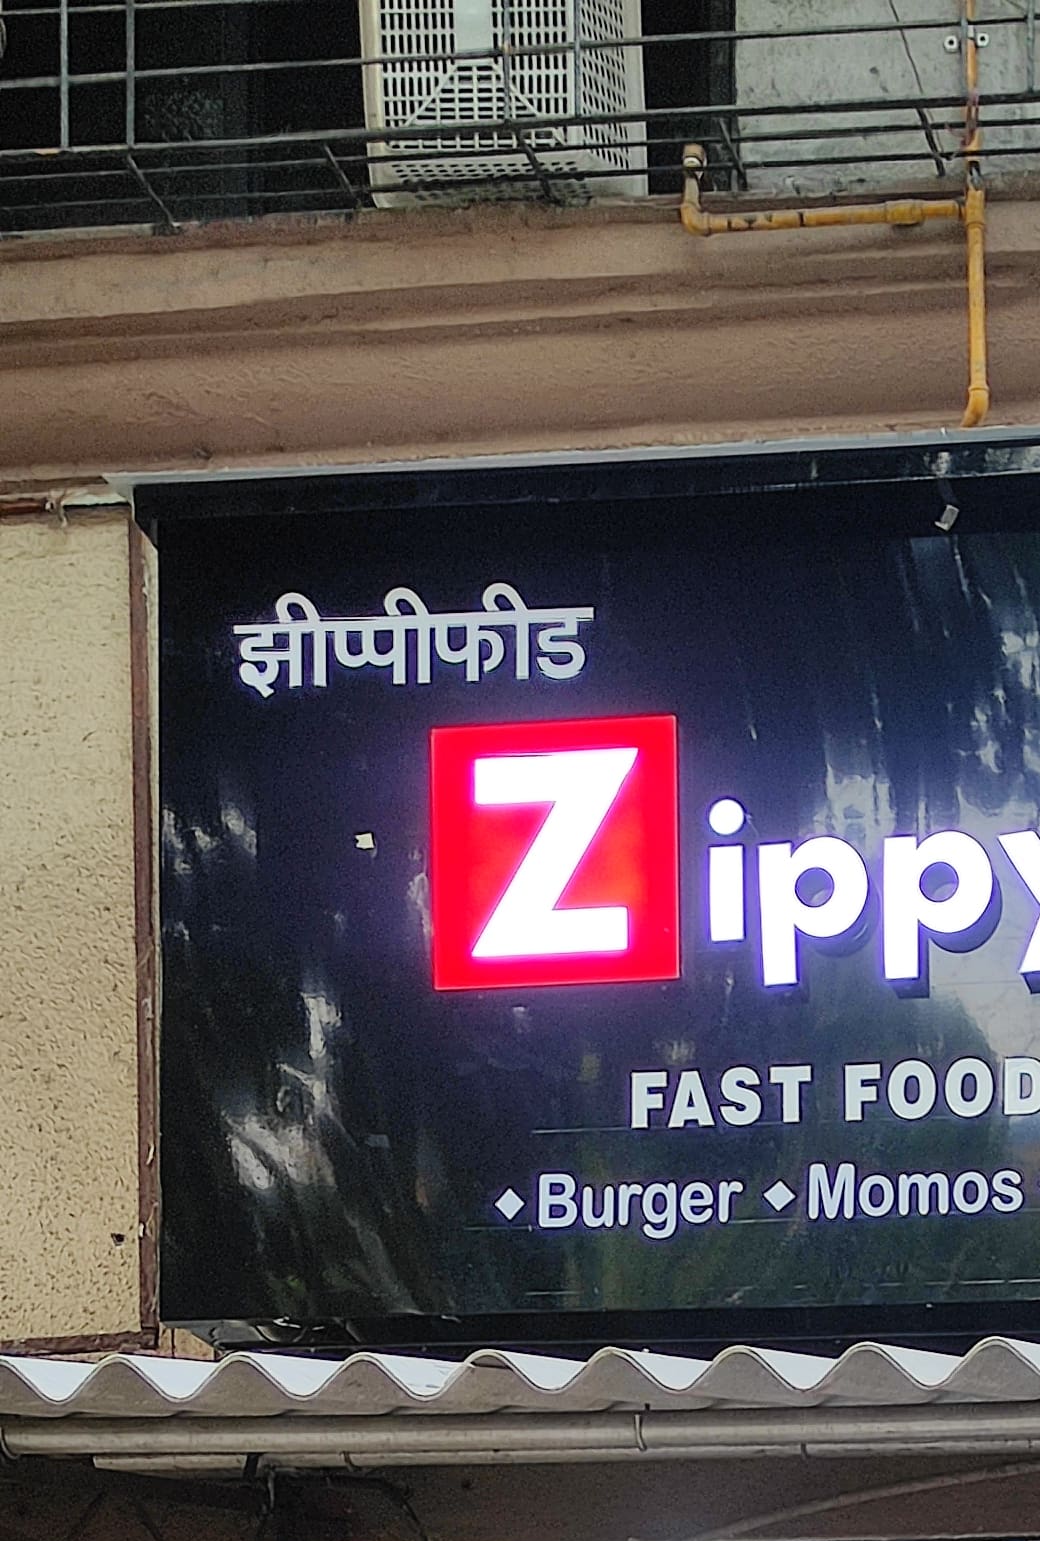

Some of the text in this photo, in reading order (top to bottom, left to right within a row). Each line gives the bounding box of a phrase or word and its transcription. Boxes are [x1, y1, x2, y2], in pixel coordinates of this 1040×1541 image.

[233, 583, 594, 697] झीप्पीफीड
[630, 1064, 813, 1129] FAST
[537, 1173, 743, 1240] Burger
[807, 1163, 1024, 1220] Momos
